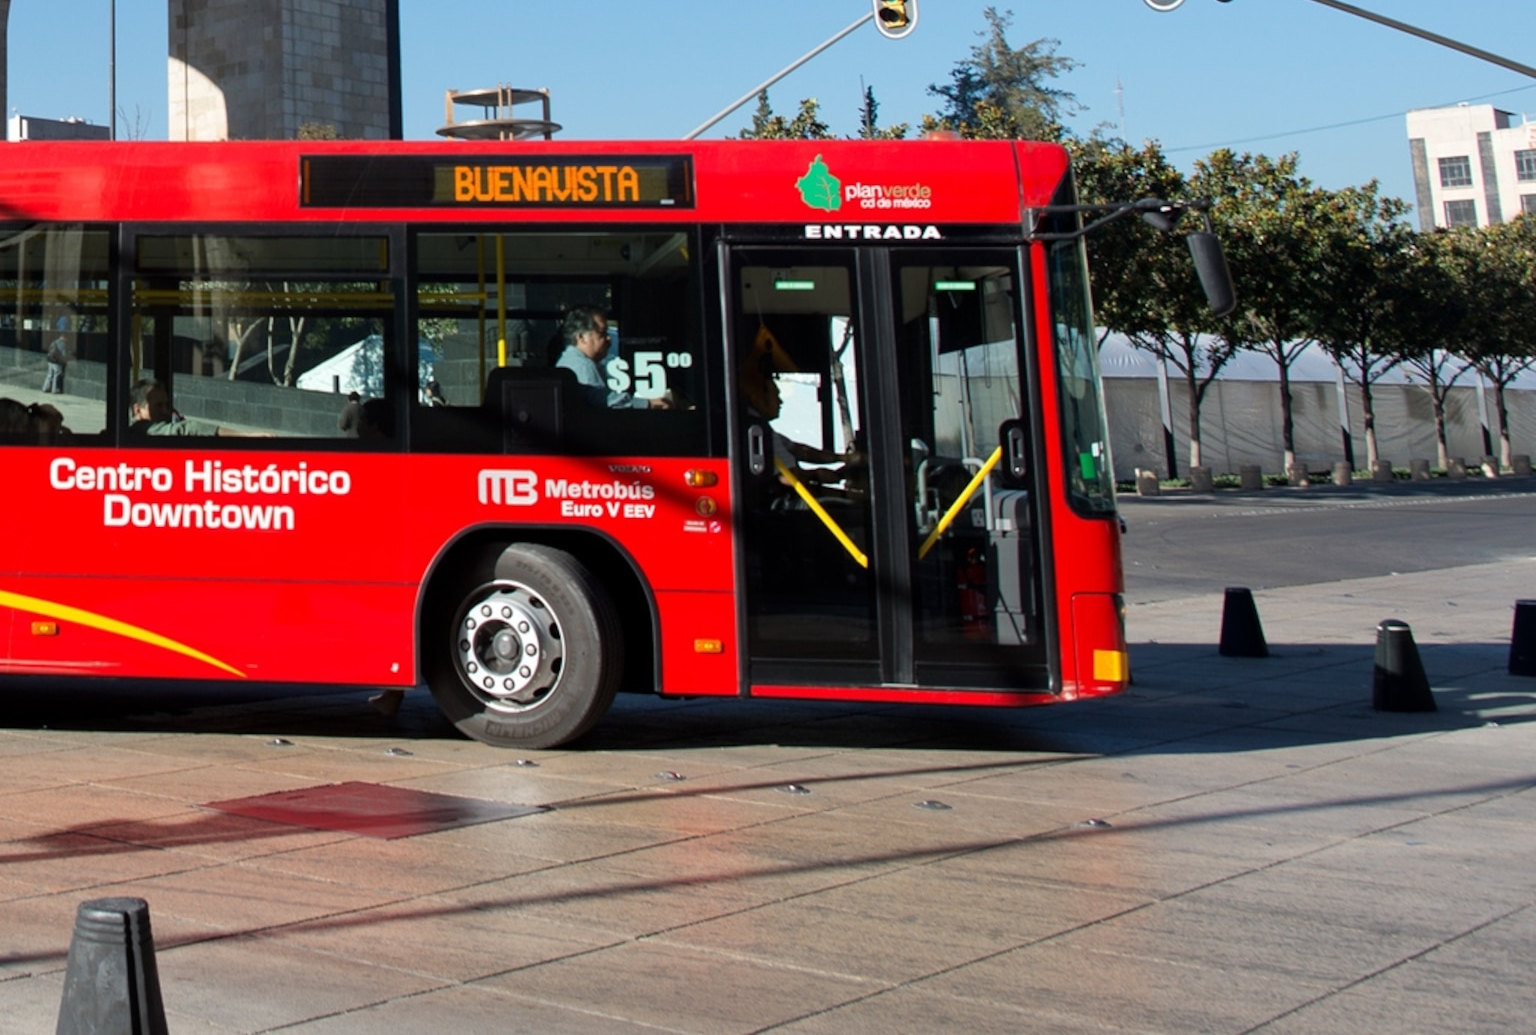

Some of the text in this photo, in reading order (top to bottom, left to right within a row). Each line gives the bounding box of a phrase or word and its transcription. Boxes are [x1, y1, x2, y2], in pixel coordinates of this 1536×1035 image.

[454, 165, 640, 202] BUENAVISTA
[860, 196, 931, 209] cd de méxico
[804, 225, 941, 239] ENTRADA
[49, 457, 351, 495] Centro Histórico
[545, 479, 655, 500] Metrobús
[103, 493, 295, 531] Downtown
[561, 500, 655, 518] Euro V EEV
